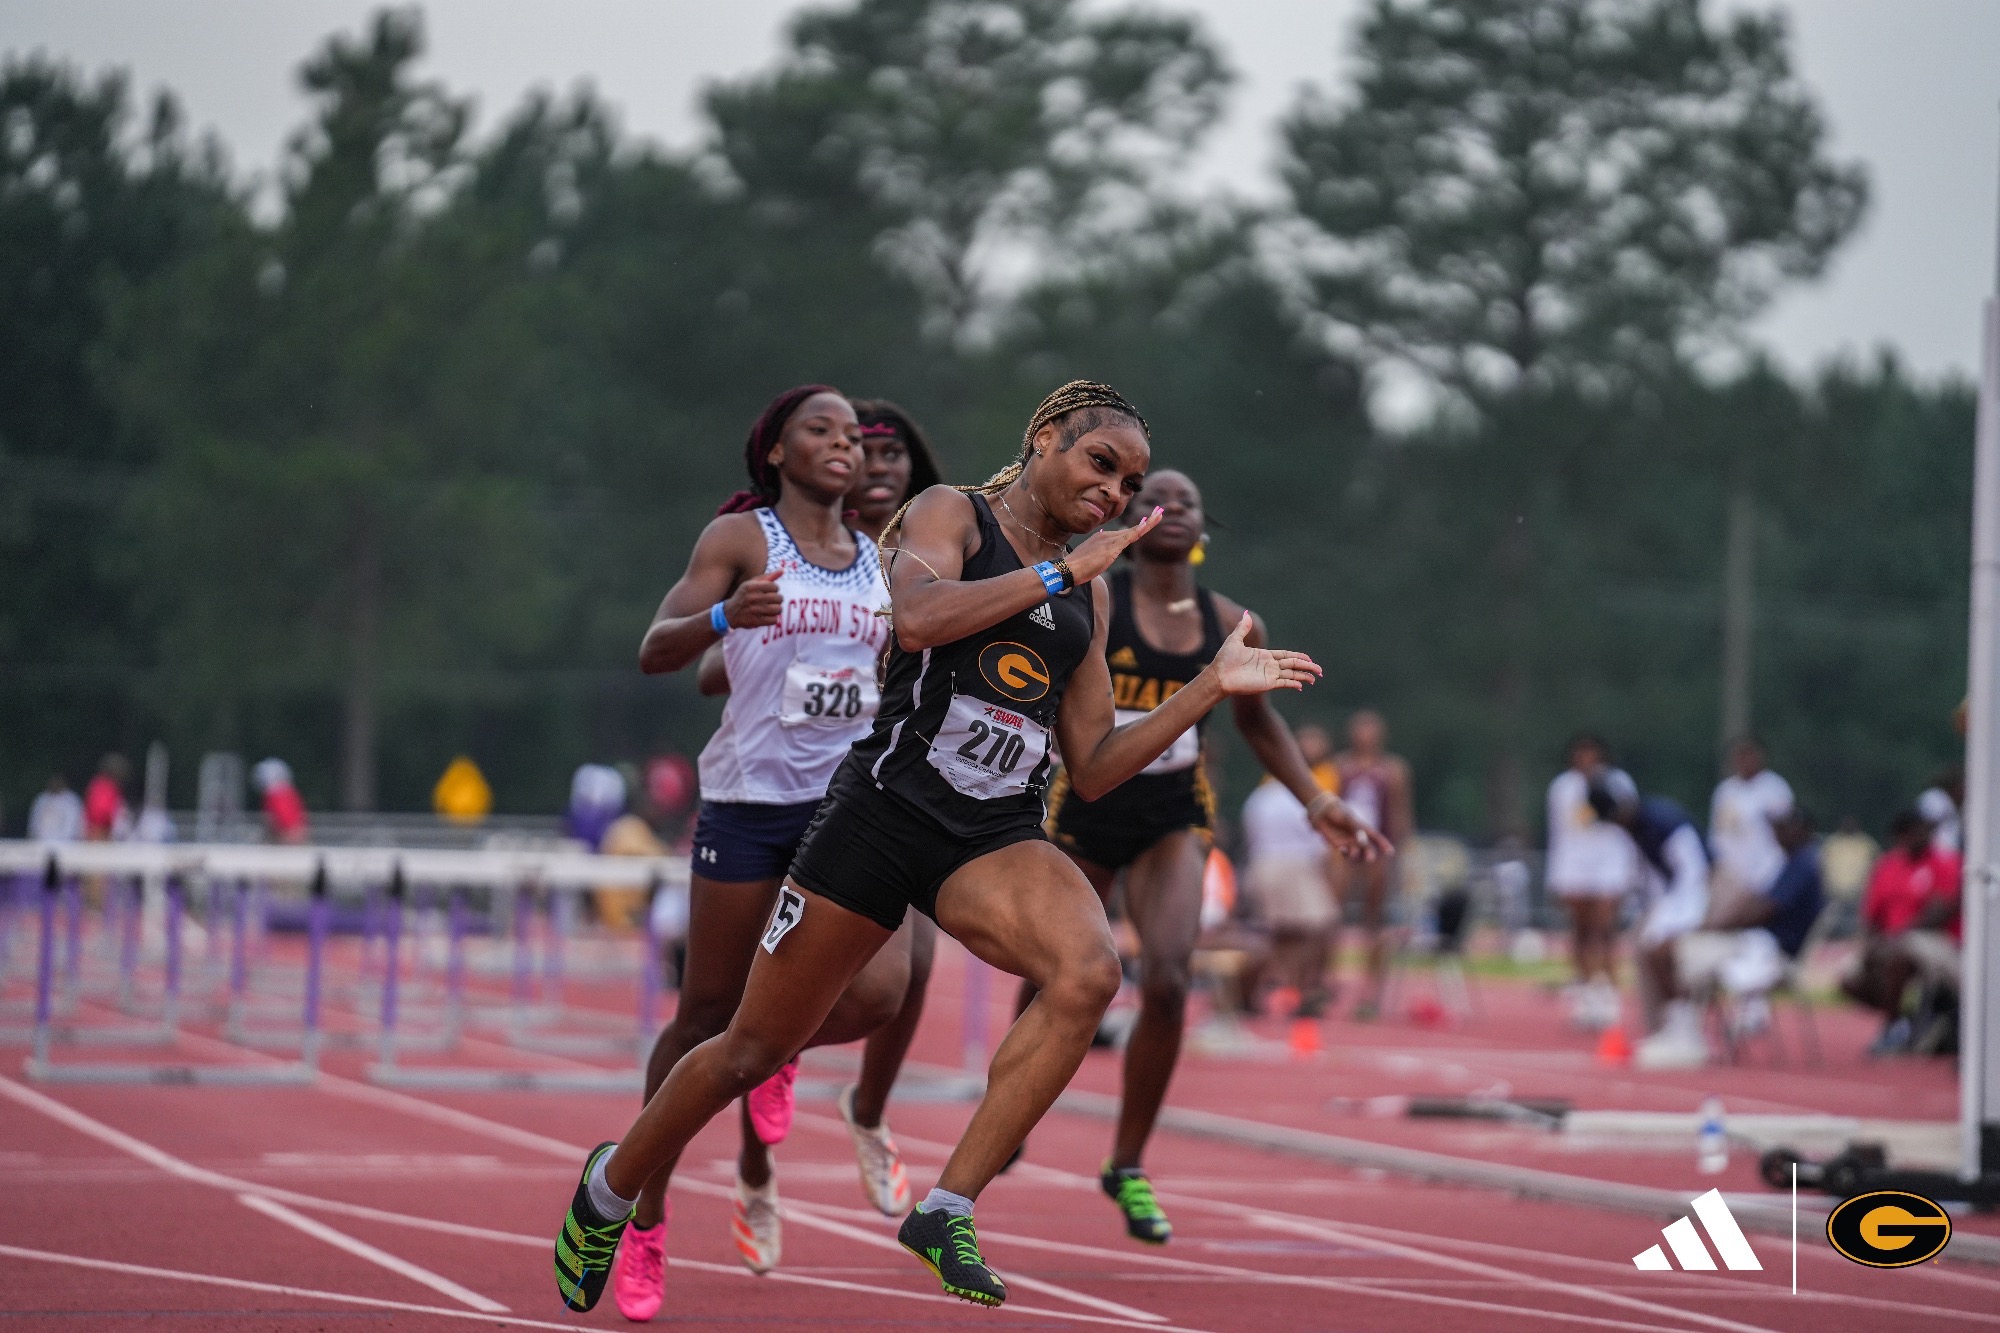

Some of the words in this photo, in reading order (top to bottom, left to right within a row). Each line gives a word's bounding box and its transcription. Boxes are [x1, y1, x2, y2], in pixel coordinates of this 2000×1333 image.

[848, 604, 885, 649] STA
[1029, 612, 1056, 630] adidas
[804, 682, 862, 718] 328
[993, 709, 1024, 731] SWAC
[957, 719, 1025, 774] 270
[767, 891, 801, 945] 5
